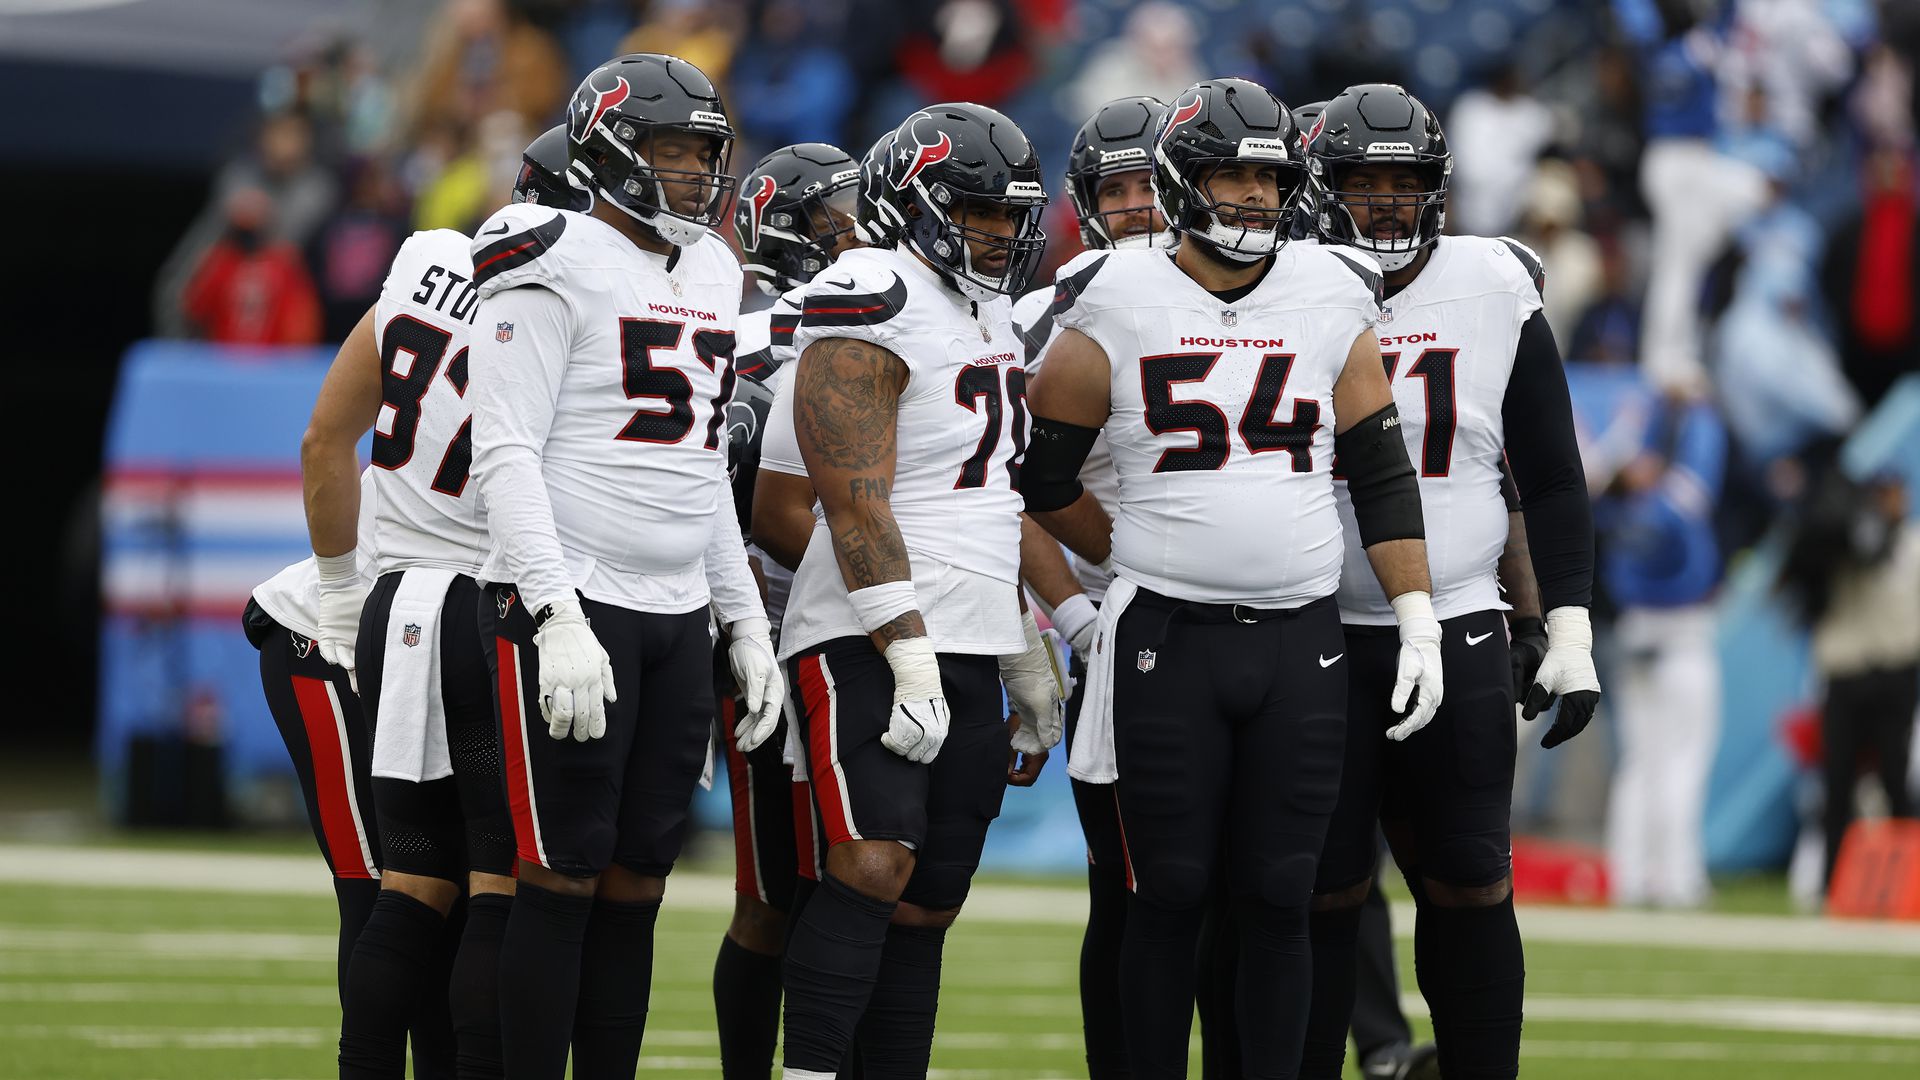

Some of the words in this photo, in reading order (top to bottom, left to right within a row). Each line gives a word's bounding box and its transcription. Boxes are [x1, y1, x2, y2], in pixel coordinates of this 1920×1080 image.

[697, 113, 725, 122] TEXANS
[1247, 142, 1283, 151] TEXANS
[1104, 150, 1142, 160] TEXANS
[412, 265, 480, 325] STO
[648, 303, 717, 321] HOUSTON
[1180, 336, 1284, 349] HOUSTON
[1378, 332, 1437, 346] STON
[973, 352, 1017, 366] HOUSTON
[613, 316, 737, 451] 57
[1139, 352, 1324, 473] 54
